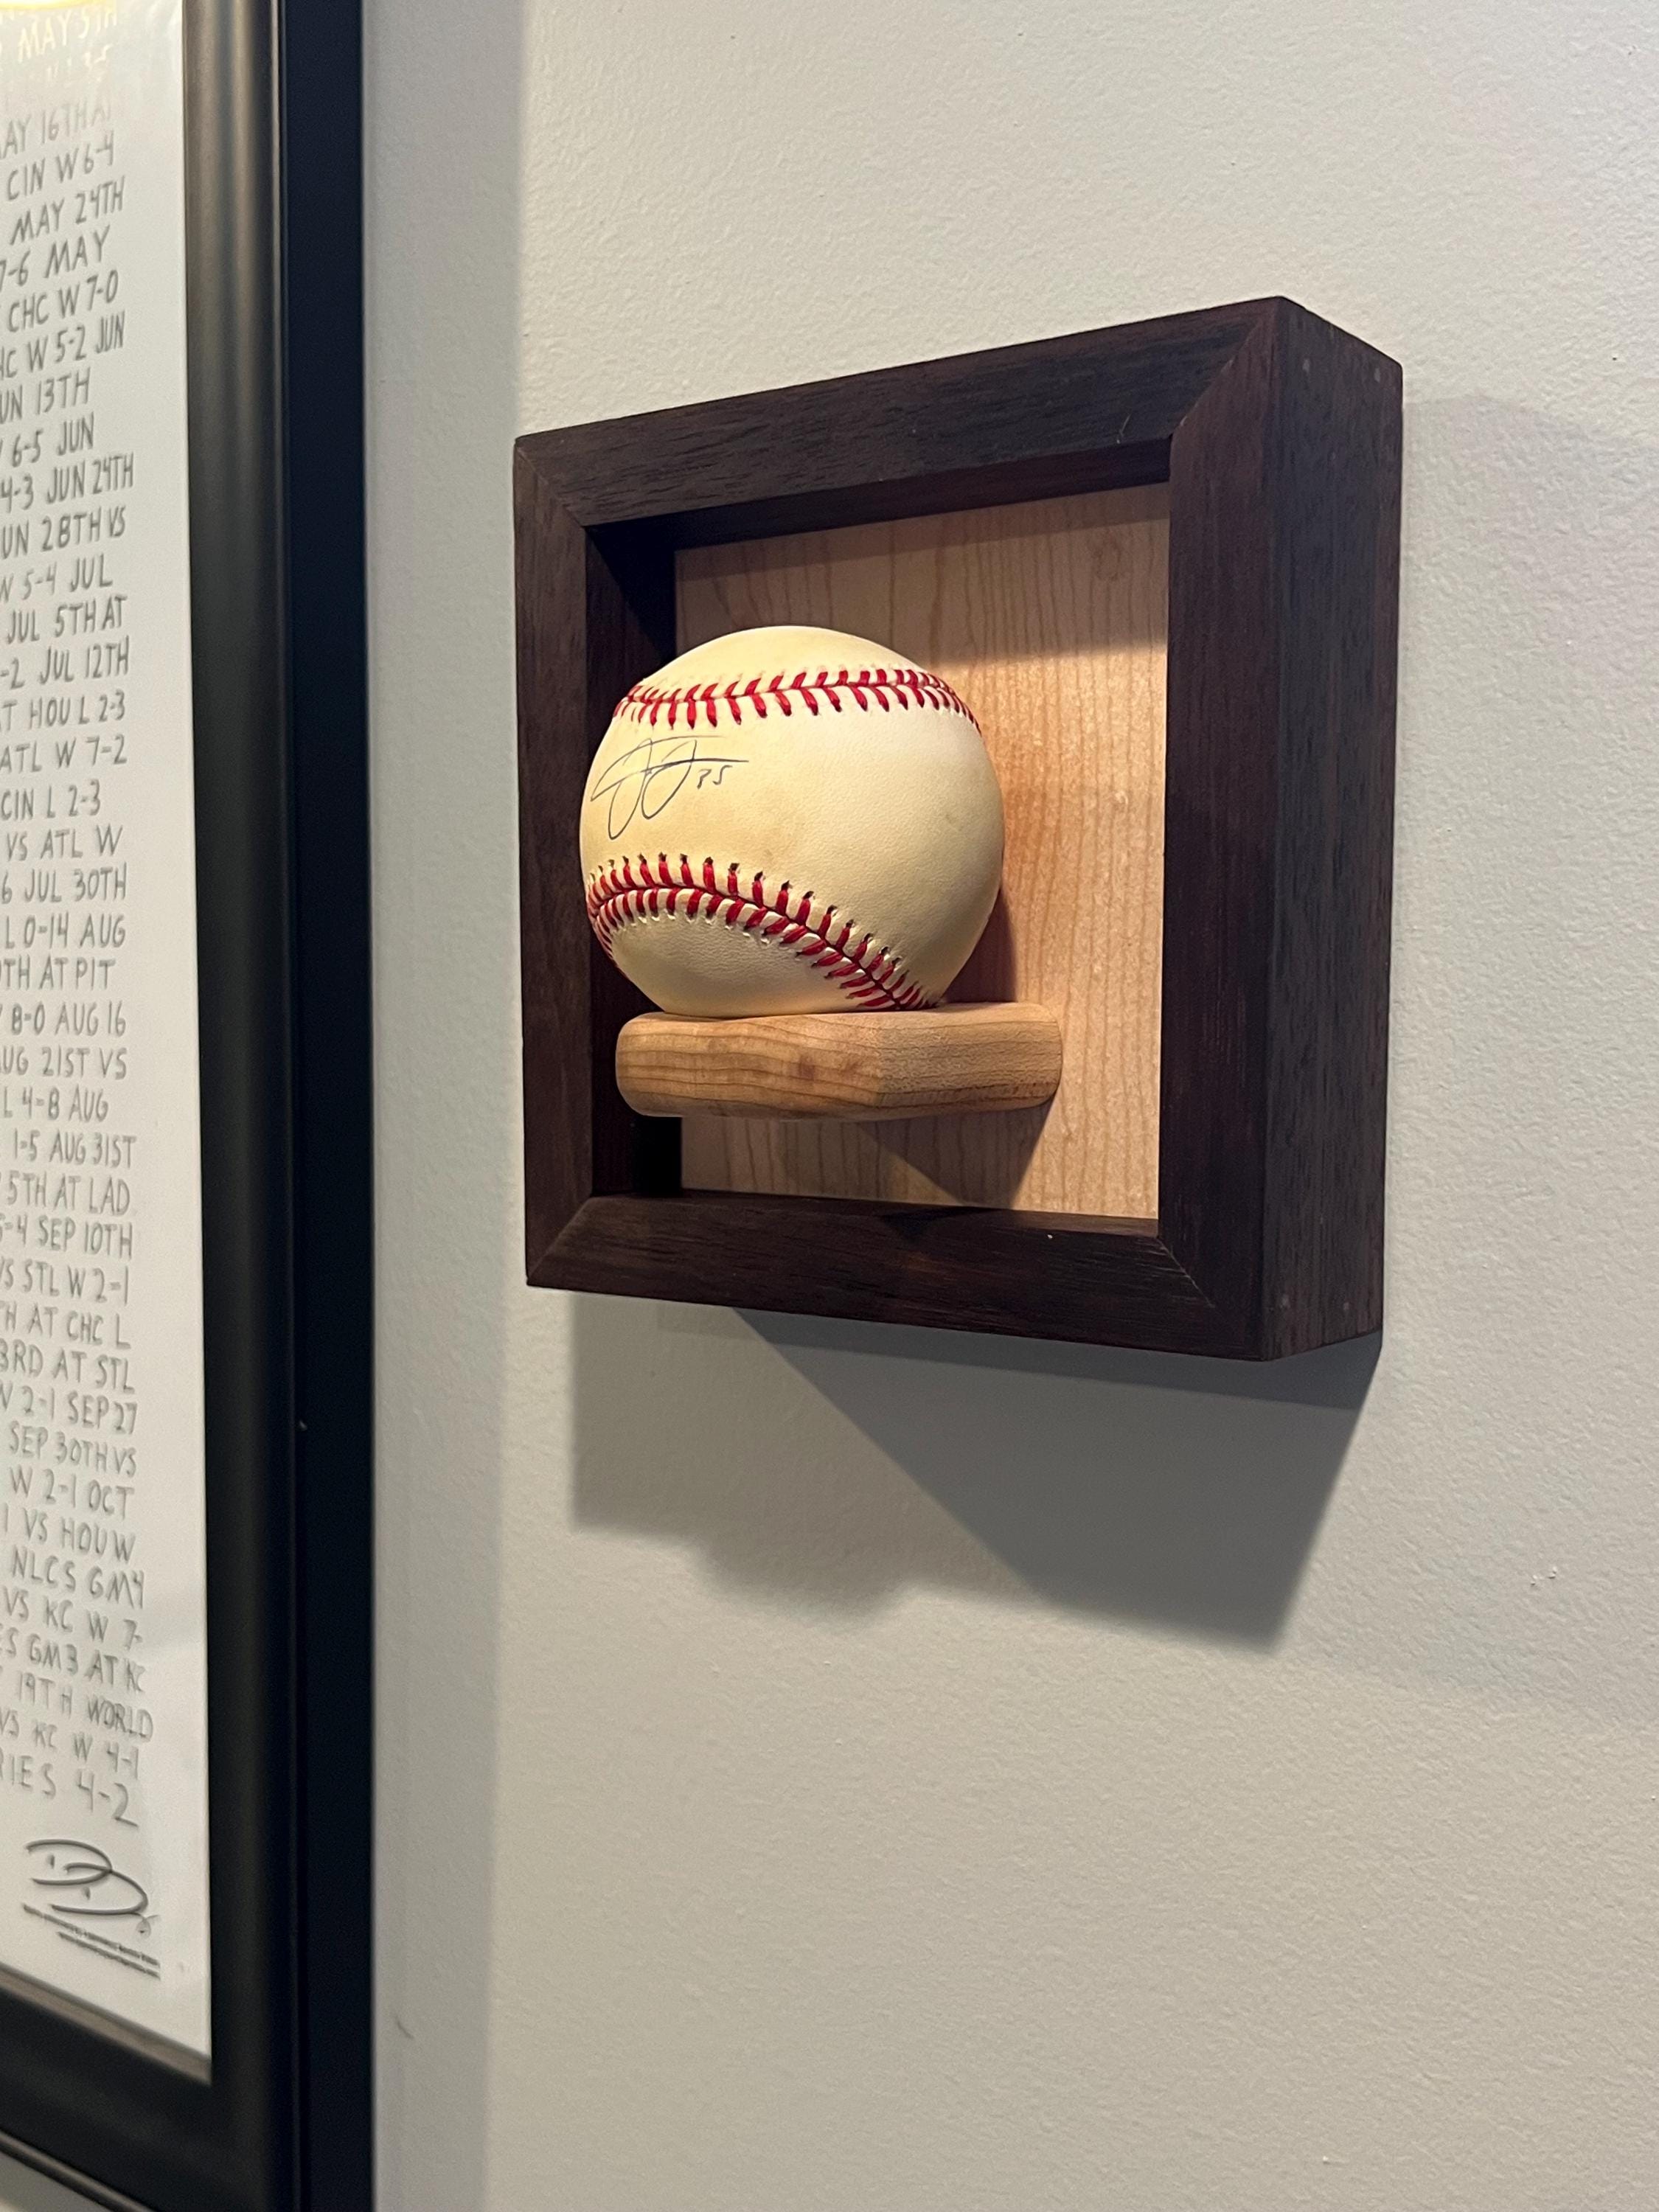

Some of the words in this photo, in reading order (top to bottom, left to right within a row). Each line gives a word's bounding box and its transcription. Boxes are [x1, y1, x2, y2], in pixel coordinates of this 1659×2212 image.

[0, 114, 32, 159] AY
[7, 158, 45, 201] CIN
[83, 130, 114, 174] 6-4
[10, 198, 65, 246] MAY
[75, 175, 125, 224] 24TH
[44, 224, 111, 279] MAY
[8, 293, 49, 333] CHC
[87, 269, 119, 310] 7-0
[55, 324, 87, 364] 5-2
[95, 309, 125, 354] JUN
[36, 366, 91, 415] 13TH
[12, 428, 44, 467] 6-5
[58, 411, 94, 456] JUN
[46, 460, 86, 504] JUN
[92, 451, 134, 495] 24TH
[41, 506, 102, 552] 28TH
[109, 505, 126, 538] VS
[23, 561, 58, 600] 5-4
[70, 553, 113, 593] JUL
[7, 609, 41, 645] JUL
[55, 597, 97, 638] 5TH
[101, 593, 128, 630] AT
[38, 646, 75, 685] JUL
[85, 634, 130, 679] 12TH
[0, 700, 18, 733] T
[29, 696, 72, 730] HOU
[98, 689, 125, 723] 2-3
[0, 740, 42, 774] ATL
[86, 734, 128, 766] 7-2
[1, 788, 35, 822] CIN
[68, 779, 101, 817] 2-3
[7, 830, 28, 861] VS
[40, 828, 84, 860] ATL
[24, 868, 63, 903] JUL
[73, 861, 128, 902] 30TH
[24, 911, 69, 950] 0-14
[79, 913, 126, 949] AUG
[0, 954, 31, 991] TH
[39, 955, 69, 991] AT
[75, 957, 116, 991] PIT
[12, 1001, 46, 1036] 8-0
[55, 1001, 100, 1037] AUG
[108, 999, 127, 1037] 16
[0, 1045, 29, 1076] UG
[41, 1044, 91, 1078] 21ST
[99, 1047, 128, 1080] VS
[22, 1086, 60, 1121] 4-8
[69, 1084, 109, 1122] AUG
[49, 1128, 86, 1165] AUG
[93, 1132, 138, 1169] 31ST
[7, 1169, 48, 1209] 5TH
[53, 1172, 82, 1211] AT
[88, 1175, 131, 1217] LAD
[38, 1214, 77, 1253] SEP
[83, 1220, 133, 1261] 10TH
[23, 1258, 60, 1297] STL
[92, 1265, 130, 1307] 2-1
[27, 1302, 59, 1339] AT
[66, 1310, 104, 1346] CHC
[52, 1347, 88, 1384] AT
[96, 1354, 136, 1394] STL
[21, 1385, 55, 1421] 2-1
[67, 1390, 110, 1430] SEP
[114, 1401, 138, 1436] 27
[9, 1420, 49, 1461] SEP
[55, 1430, 108, 1473] 30TH
[112, 1446, 137, 1478] VS
[42, 1468, 77, 1509] 2-1
[88, 1478, 136, 1521] OCT
[23, 1506, 49, 1543] VS
[60, 1515, 108, 1557] HOU
[11, 1544, 77, 1593] NLCS
[3, 1585, 29, 1621] VS
[43, 1594, 74, 1634] KC
[85, 1695, 154, 1742] WORLD
[105, 1741, 139, 1781] 4-1
[0, 1750, 58, 1801] IES
[76, 1769, 140, 1829] 4-2
